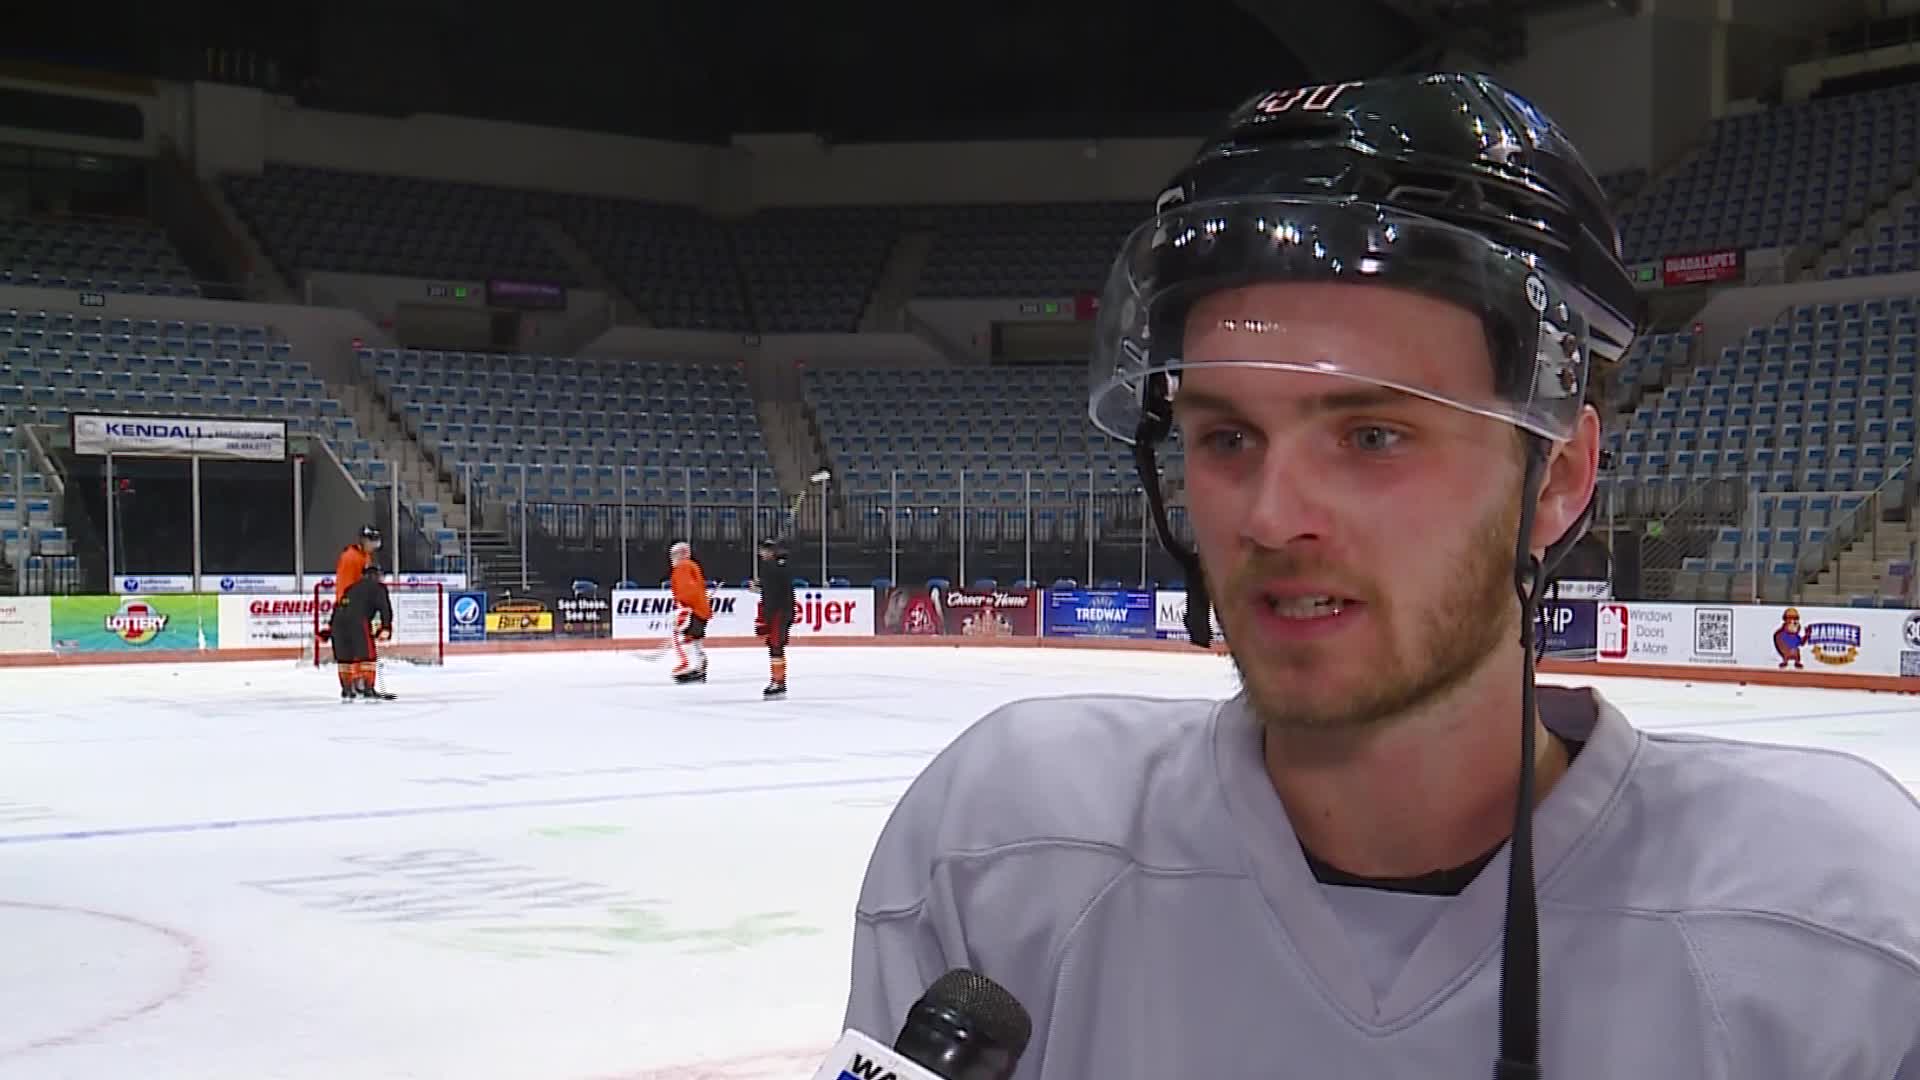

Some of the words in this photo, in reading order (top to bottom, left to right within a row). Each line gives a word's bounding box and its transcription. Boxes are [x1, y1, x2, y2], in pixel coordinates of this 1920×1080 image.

[106, 423, 204, 439] KENDALL
[992, 591, 1029, 607] Home
[757, 593, 857, 632] eijer
[1075, 607, 1129, 622] TREDWAY
[1630, 609, 1673, 622] Windows
[105, 615, 168, 631] LOTTERY
[1636, 624, 1665, 638] Doors
[1810, 625, 1858, 642] MAUMEE
[1642, 643, 1669, 655] More
